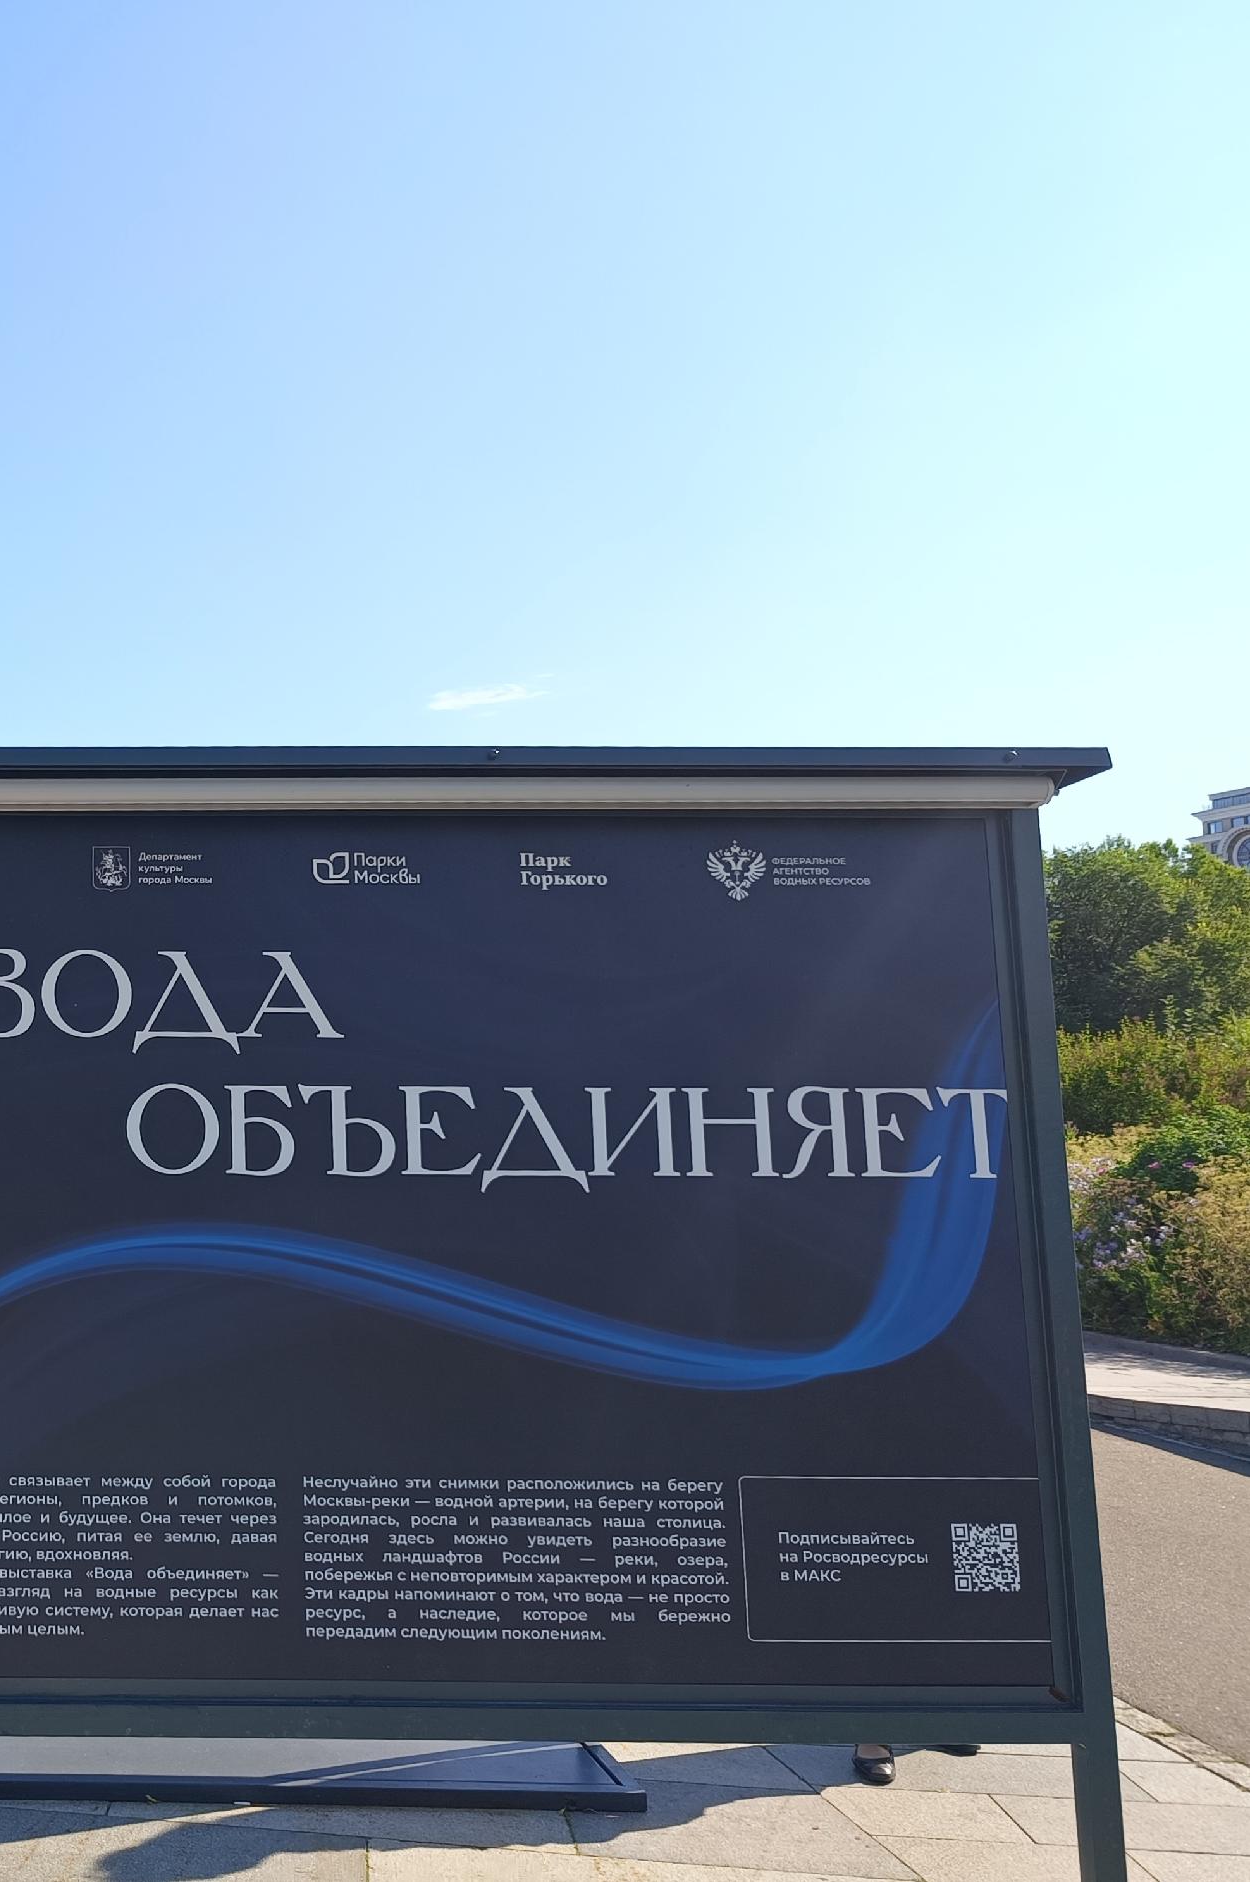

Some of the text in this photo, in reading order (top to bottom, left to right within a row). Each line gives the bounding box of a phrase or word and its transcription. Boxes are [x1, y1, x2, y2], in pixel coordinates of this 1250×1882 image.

[138, 851, 202, 863] Департамент
[353, 852, 407, 871] Парки
[519, 852, 572, 871] Парк
[771, 857, 847, 866] ФЕДЕРАЛЬНОЕ
[138, 865, 183, 874] культуры
[354, 868, 421, 884] Москвы
[772, 867, 830, 876] АГЕНТСТВО
[138, 875, 213, 886] города Москвы
[520, 870, 608, 891] Горького
[773, 877, 871, 887] ВОДНЫХ РЕСУРСОВ
[126, 1083, 1008, 1194] ОБЪЕДИНЯЕТ
[8, 1476, 91, 1487] связывает
[101, 1477, 154, 1490] между
[163, 1474, 211, 1488] собой
[221, 1478, 276, 1491] города
[303, 1475, 724, 1495] Неслучайно эти снимки расположились на берегу
[82, 1495, 149, 1509] предков
[168, 1495, 178, 1506] и
[198, 1495, 277, 1509] потомков,
[303, 1494, 410, 1510] Москвы-реки
[434, 1494, 494, 1509] водной
[498, 1497, 570, 1511] артерии,
[574, 1498, 593, 1509] на
[598, 1495, 654, 1512] берегу
[658, 1497, 724, 1513] которой
[40, 1513, 50, 1524] и
[58, 1510, 132, 1527] будущее.
[140, 1511, 171, 1524] Она
[178, 1514, 223, 1524] течет
[230, 1514, 277, 1528] через
[302, 1514, 726, 1531] зародилась, росла и развивалась наша столица.
[2, 1529, 66, 1545] Россию,
[76, 1531, 123, 1542] питая
[133, 1532, 153, 1543] ее
[164, 1532, 220, 1545] землю,
[230, 1533, 277, 1545] давая
[303, 1531, 727, 1550] Сегодня здесь можно увидеть разнообразие
[778, 1531, 915, 1546] Подписывайтесь
[36, 1550, 133, 1562] вдохновляя.
[304, 1552, 364, 1564] водных
[382, 1550, 483, 1566] ландшафтов
[502, 1551, 560, 1565] России
[614, 1555, 658, 1569] реки,
[677, 1555, 729, 1569] озера,
[779, 1550, 929, 1567] на Росводресурсы
[85, 1566, 133, 1581] «Вода
[146, 1566, 250, 1582] объединяет»
[304, 1567, 730, 1588] побережья с неповторимым характером и красотой.
[780, 1569, 842, 1582] в МАКС
[64, 1587, 83, 1598] на
[96, 1588, 157, 1600] водные
[169, 1588, 238, 1602] ресурсы
[251, 1588, 279, 1600] как
[304, 1586, 333, 1600] Эти
[338, 1589, 389, 1603] кадры
[394, 1590, 497, 1602] напоминают
[500, 1591, 511, 1602] о
[514, 1591, 549, 1605] том,
[552, 1591, 580, 1602] что
[584, 1592, 623, 1605] вода
[648, 1593, 669, 1603] не
[673, 1593, 730, 1607] просто
[45, 1606, 114, 1620] систему,
[120, 1606, 183, 1620] которая
[188, 1607, 245, 1619] делает
[251, 1607, 279, 1618] нас
[305, 1608, 731, 1626] ресурс, а наследие, которое мы бережно
[27, 1624, 85, 1637] целым.
[305, 1627, 606, 1642] передадим следующим поколениям.
